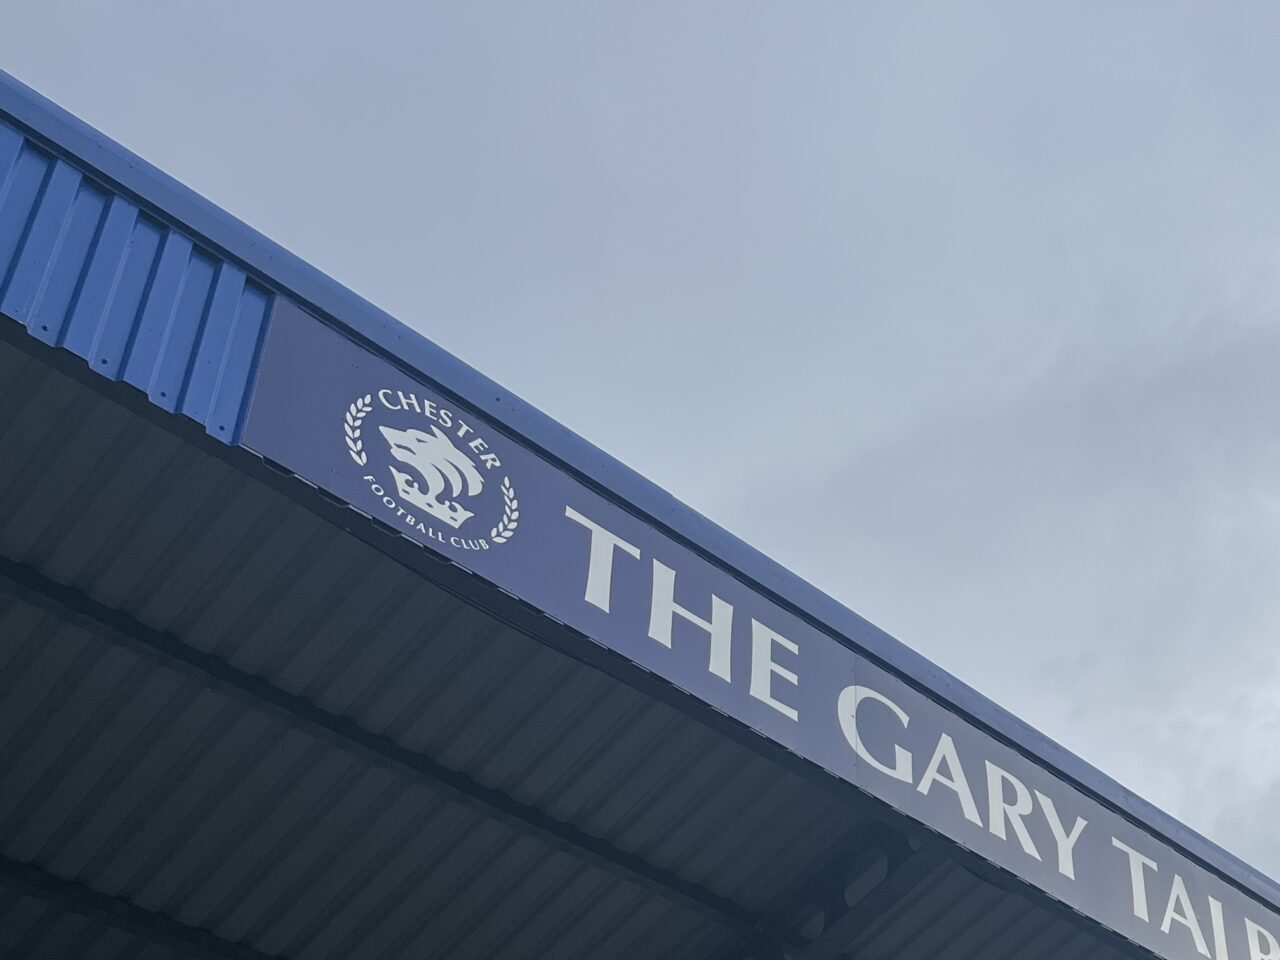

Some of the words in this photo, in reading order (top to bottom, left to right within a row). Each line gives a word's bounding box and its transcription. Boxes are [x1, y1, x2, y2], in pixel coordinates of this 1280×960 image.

[378, 389, 501, 470] CHESTER
[363, 475, 446, 543] FOOTBALL
[450, 536, 489, 550] CLUB
[565, 504, 799, 722] THE
[837, 684, 1089, 881] GARY
